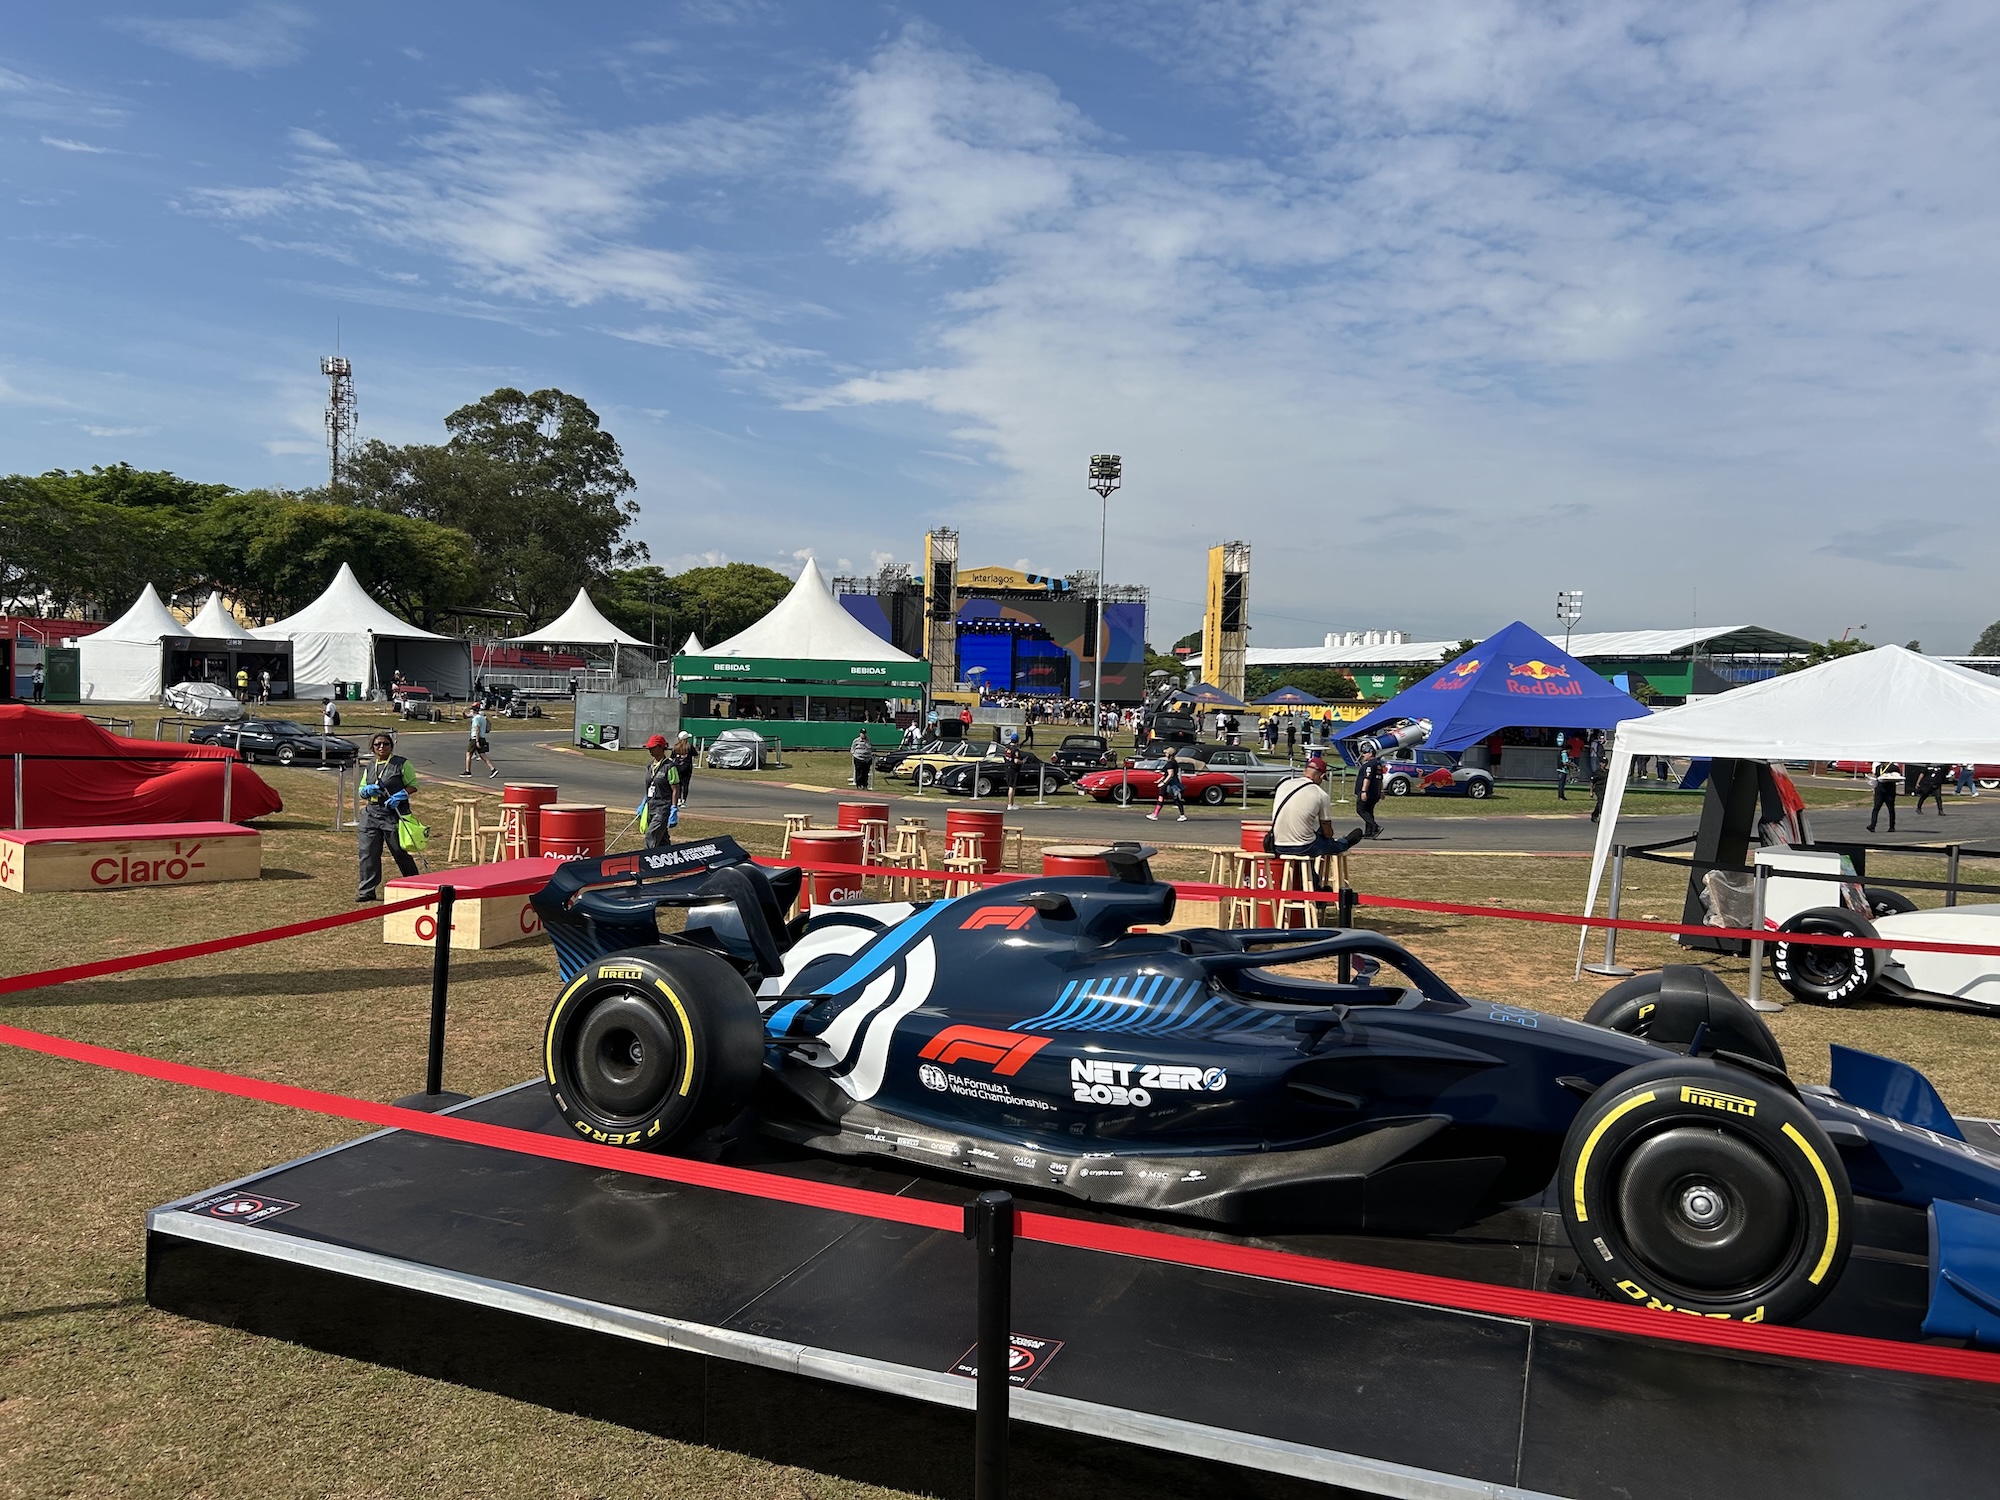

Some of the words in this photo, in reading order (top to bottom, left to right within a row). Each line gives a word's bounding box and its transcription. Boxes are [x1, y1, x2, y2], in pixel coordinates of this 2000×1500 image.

[972, 573, 1014, 585] Interlagos
[714, 663, 751, 672] BEBIDAS
[850, 667, 886, 675] BEBIDAS
[1506, 679, 1543, 695] Red
[1544, 681, 1583, 696] Bull
[644, 851, 684, 869] 100%
[91, 857, 188, 885] Claro
[830, 888, 862, 903] Clar
[958, 906, 1037, 930] F1
[1776, 929, 1793, 982] EAGL
[598, 965, 644, 980] PIRELLI
[917, 1024, 1054, 1076] F1
[1070, 1058, 1137, 1086] NET
[1139, 1065, 1227, 1091] ZERO
[948, 1074, 964, 1085] FIA
[964, 1077, 1004, 1094] Formula
[1003, 1085, 1010, 1095] 1
[950, 1084, 977, 1097] World
[978, 1091, 1049, 1110] Championship
[1071, 1081, 1152, 1107] 2030
[1680, 1085, 1757, 1117] PIRELLI
[574, 1120, 642, 1145] ZERO
[647, 1118, 662, 1138] P
[865, 1133, 885, 1142] ROLEX
[1013, 1155, 1037, 1165] QATAR
[1049, 1162, 1068, 1172] aws
[1089, 1169, 1123, 1177] crypto.com
[1148, 1171, 1169, 1179] MSC
